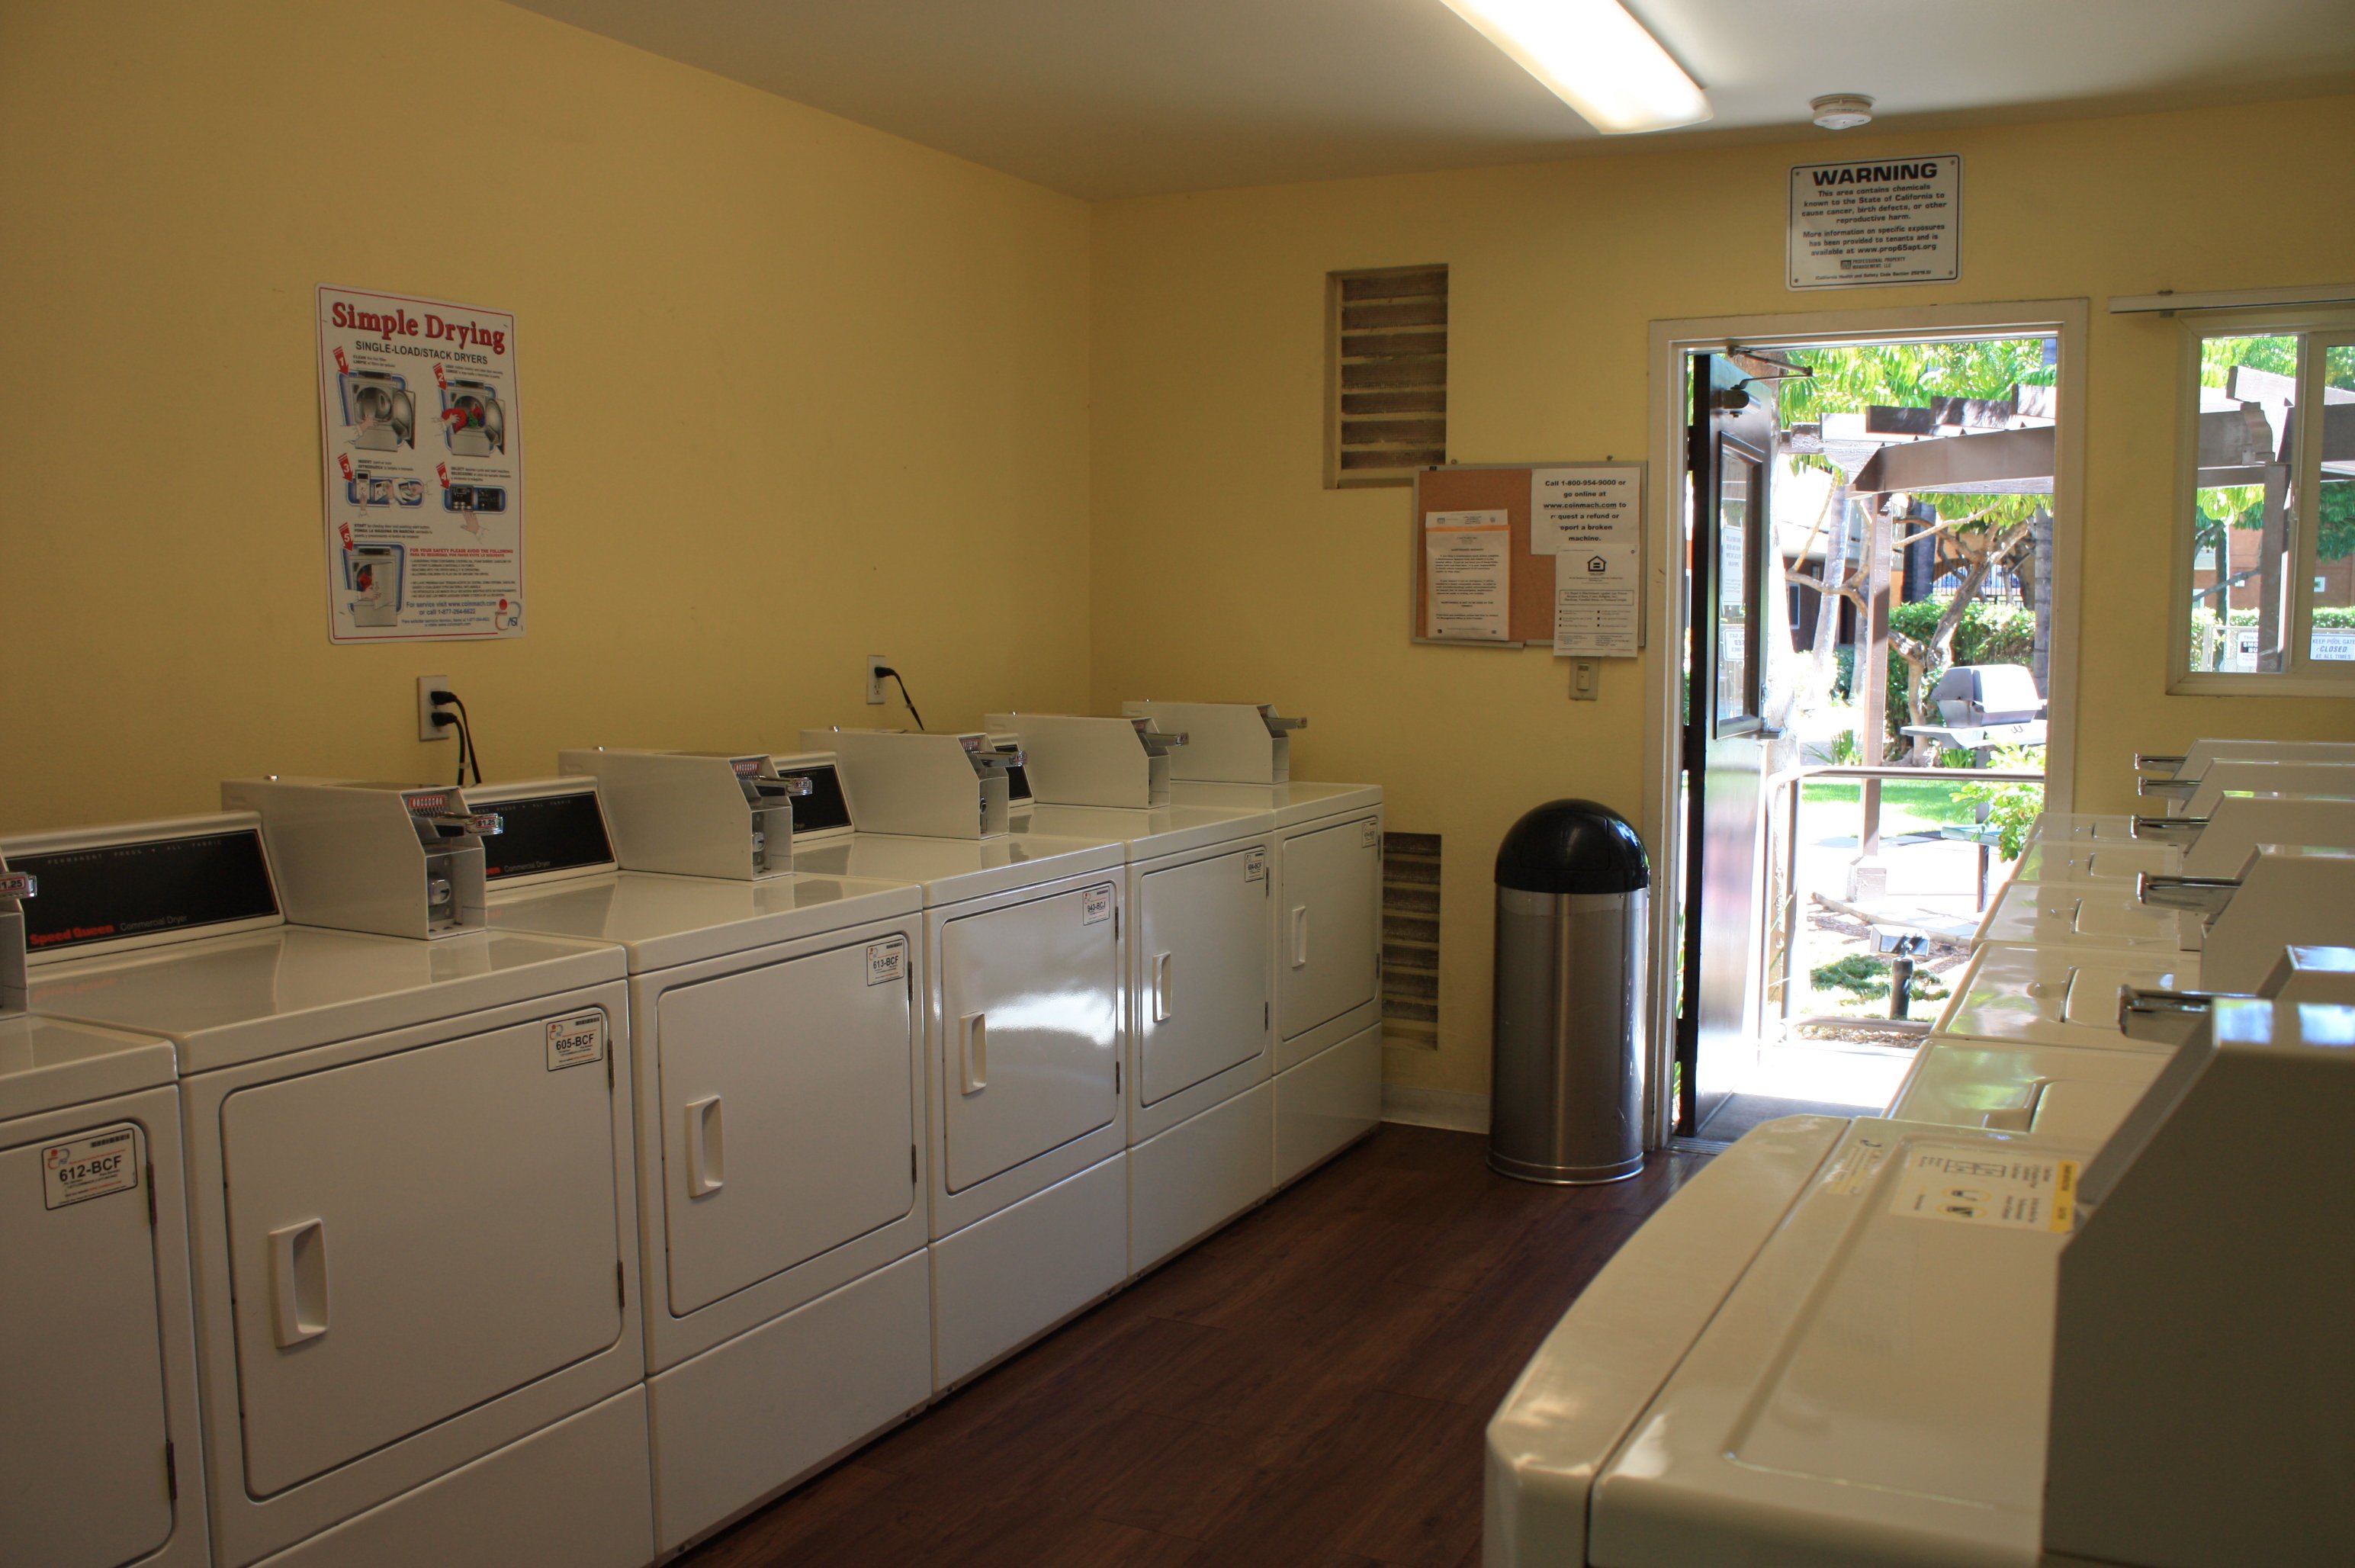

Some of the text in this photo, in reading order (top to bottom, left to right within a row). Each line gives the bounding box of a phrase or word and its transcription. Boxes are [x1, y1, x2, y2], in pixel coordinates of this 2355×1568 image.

[1812, 162, 1937, 186] WARNING
[1892, 183, 1930, 192] chemicals
[1895, 193, 1933, 201] California
[1878, 204, 1910, 212] defects,
[1836, 214, 1885, 224] reproductive
[1824, 228, 1864, 236] information
[1878, 226, 1904, 234] specific
[1843, 237, 1872, 246] provided
[1857, 243, 1936, 254] www.prop65apt.org
[332, 301, 506, 355] Simple Drying
[355, 340, 488, 365] SINGLE-LOAD/STACK DRYERS
[477, 819, 496, 827] $1.25
[503, 861, 535, 872] Commercial
[0, 879, 22, 889] 1.25
[120, 914, 188, 931] Commercial Dryer
[30, 923, 115, 946] Speed Queen
[872, 955, 899, 969] 613-BCF
[556, 1033, 594, 1050] 605-BCF
[59, 1155, 122, 1182] 612-BCF
